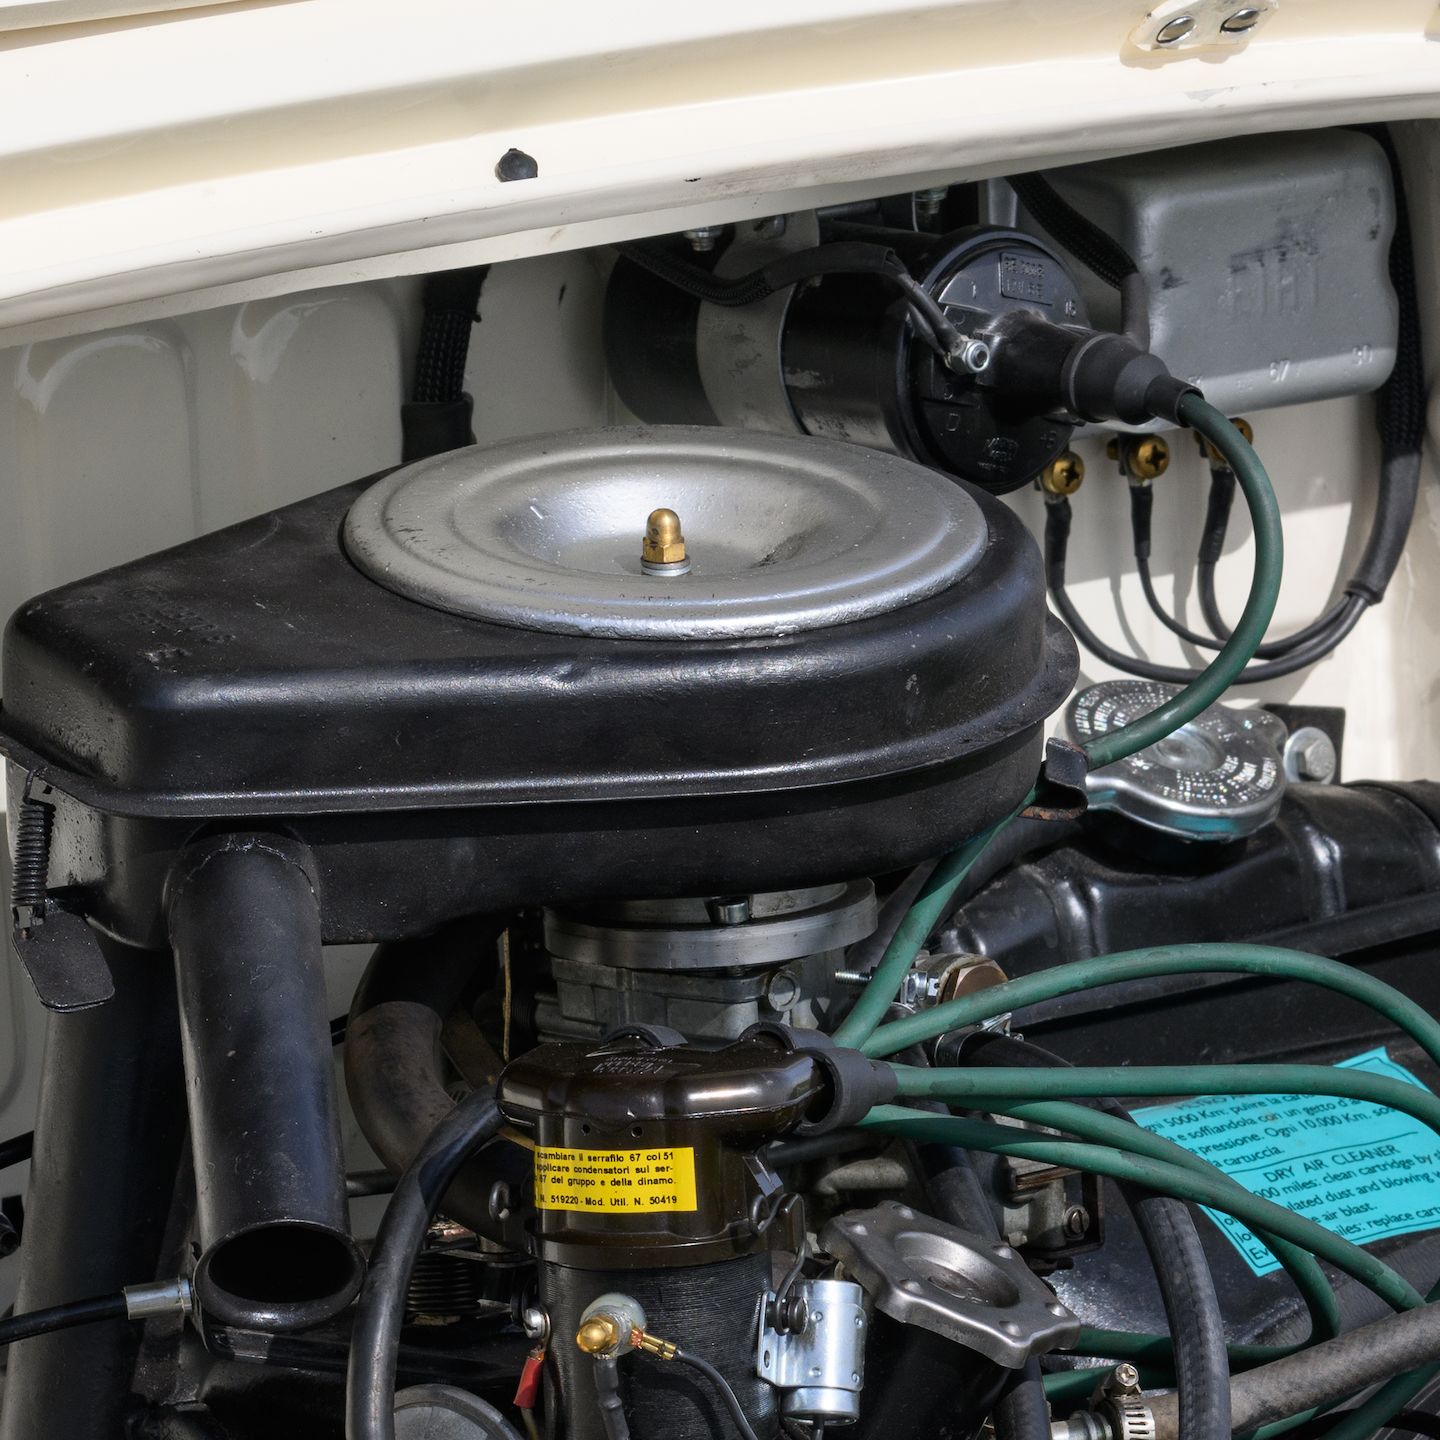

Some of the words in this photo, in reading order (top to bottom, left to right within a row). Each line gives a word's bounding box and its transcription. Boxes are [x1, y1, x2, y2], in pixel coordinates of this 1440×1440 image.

[1164, 1112, 1199, 1130] 5000
[1230, 1098, 1267, 1117] pulire
[1268, 1095, 1281, 1108] la
[1178, 1133, 1187, 1143] e
[1187, 1116, 1257, 1139] soffiandola
[1257, 1111, 1284, 1123] con
[1284, 1107, 1303, 1118] un
[1302, 1100, 1337, 1117] getto
[1198, 1132, 1265, 1156] pressione.
[1263, 1124, 1299, 1139] Ogni
[1299, 1113, 1343, 1132] 10.000
[587, 1153, 625, 1163] serrafilo
[629, 1153, 641, 1162] 67
[646, 1152, 661, 1161] col
[663, 1152, 674, 1161] 51
[1222, 1144, 1286, 1167] cartuccia.
[1262, 1166, 1296, 1184] DRY
[1303, 1158, 1328, 1174] AIR
[1331, 1143, 1401, 1167] CLEANER
[573, 1165, 631, 1175] condensatori
[635, 1165, 651, 1174] sul
[1322, 1168, 1358, 1185] clean
[1357, 1153, 1416, 1177] cartridge
[1412, 1152, 1434, 1165] by
[551, 1174, 564, 1185] del
[567, 1177, 596, 1188] gruppo
[610, 1177, 633, 1187] della
[637, 1175, 677, 1186] dinamo.
[1324, 1189, 1354, 1203] dust
[1355, 1181, 1381, 1196] and
[1380, 1170, 1436, 1190] blowing
[550, 1194, 579, 1206] 519220
[584, 1197, 605, 1207] Mod.
[610, 1197, 629, 1207] Util.
[633, 1197, 644, 1207] N.
[649, 1195, 678, 1205] 50419
[1321, 1208, 1339, 1221] air
[1339, 1201, 1379, 1218] blast.
[1365, 1212, 1416, 1231] replace
